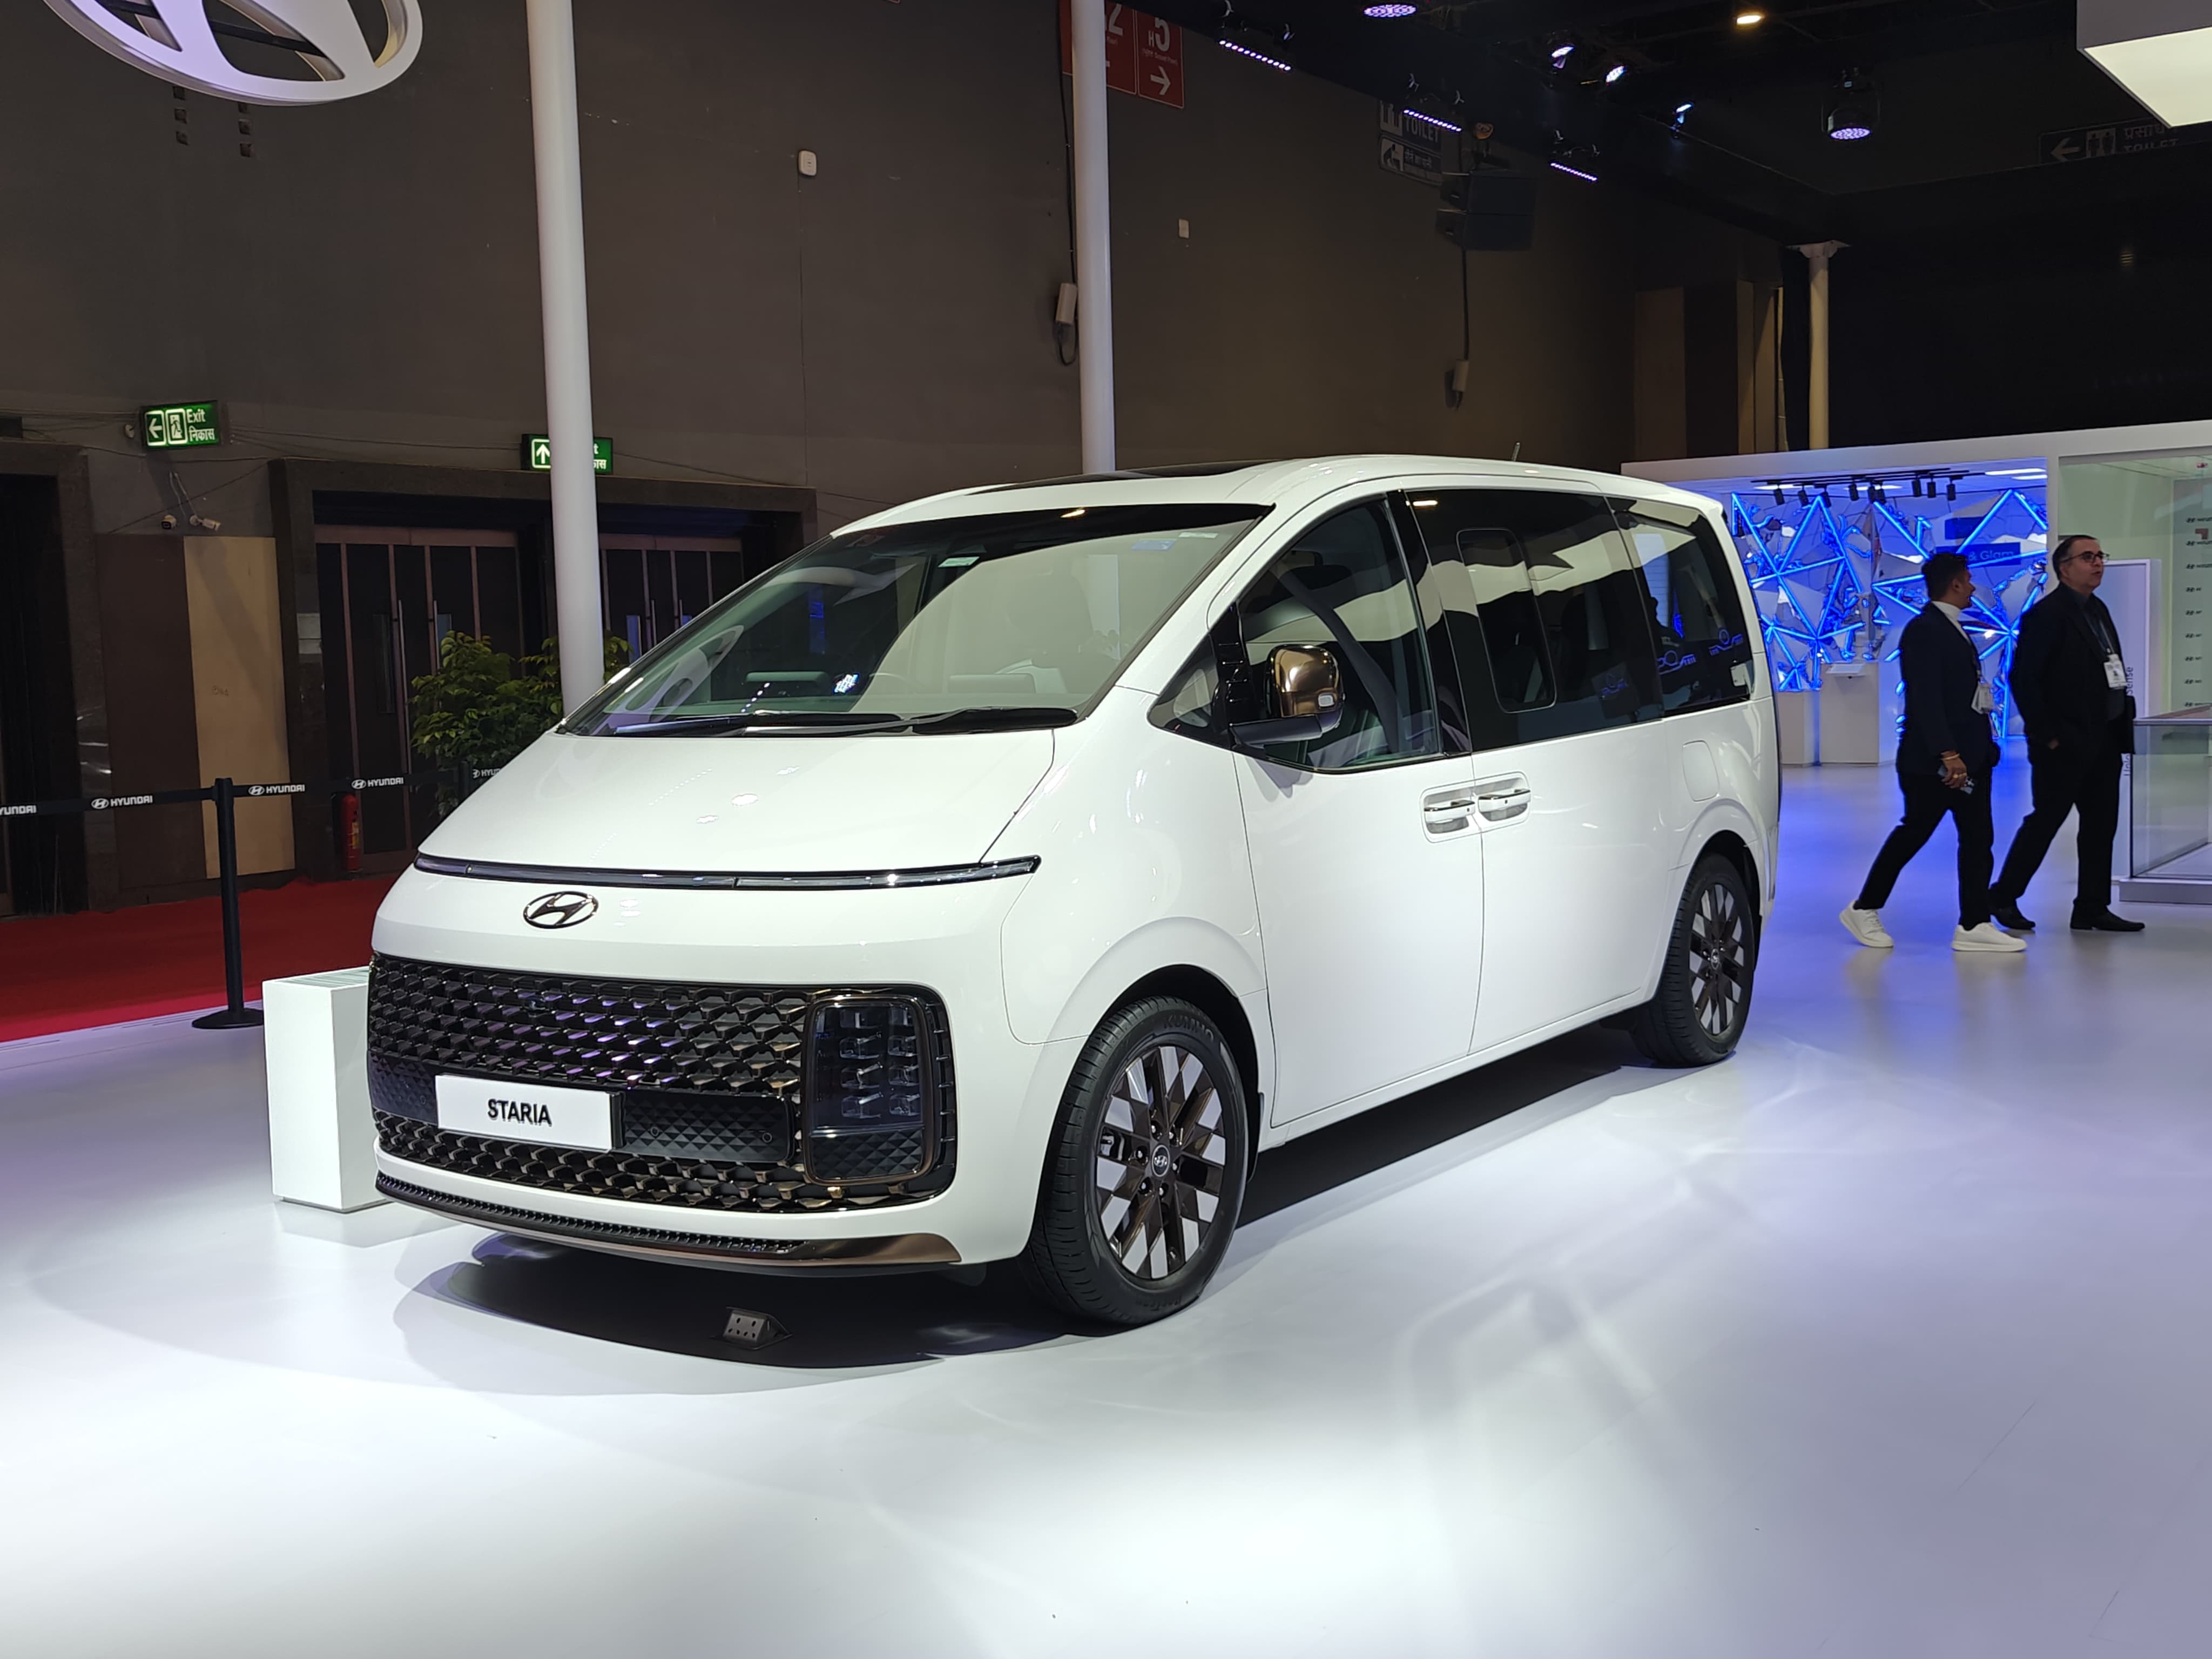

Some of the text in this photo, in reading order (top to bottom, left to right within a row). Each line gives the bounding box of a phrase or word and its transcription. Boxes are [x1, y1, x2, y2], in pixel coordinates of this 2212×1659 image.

[1403, 115, 1439, 143] TOILET
[186, 408, 206, 423] Exit
[188, 425, 215, 442] निकास
[1968, 551, 1977, 561] &
[367, 777, 404, 787] HYUNDAI
[266, 784, 306, 794] HYUNDAI
[110, 795, 153, 807] HYUNDAI
[0, 805, 37, 816] YUNDAI
[488, 1098, 551, 1125] STARIA
